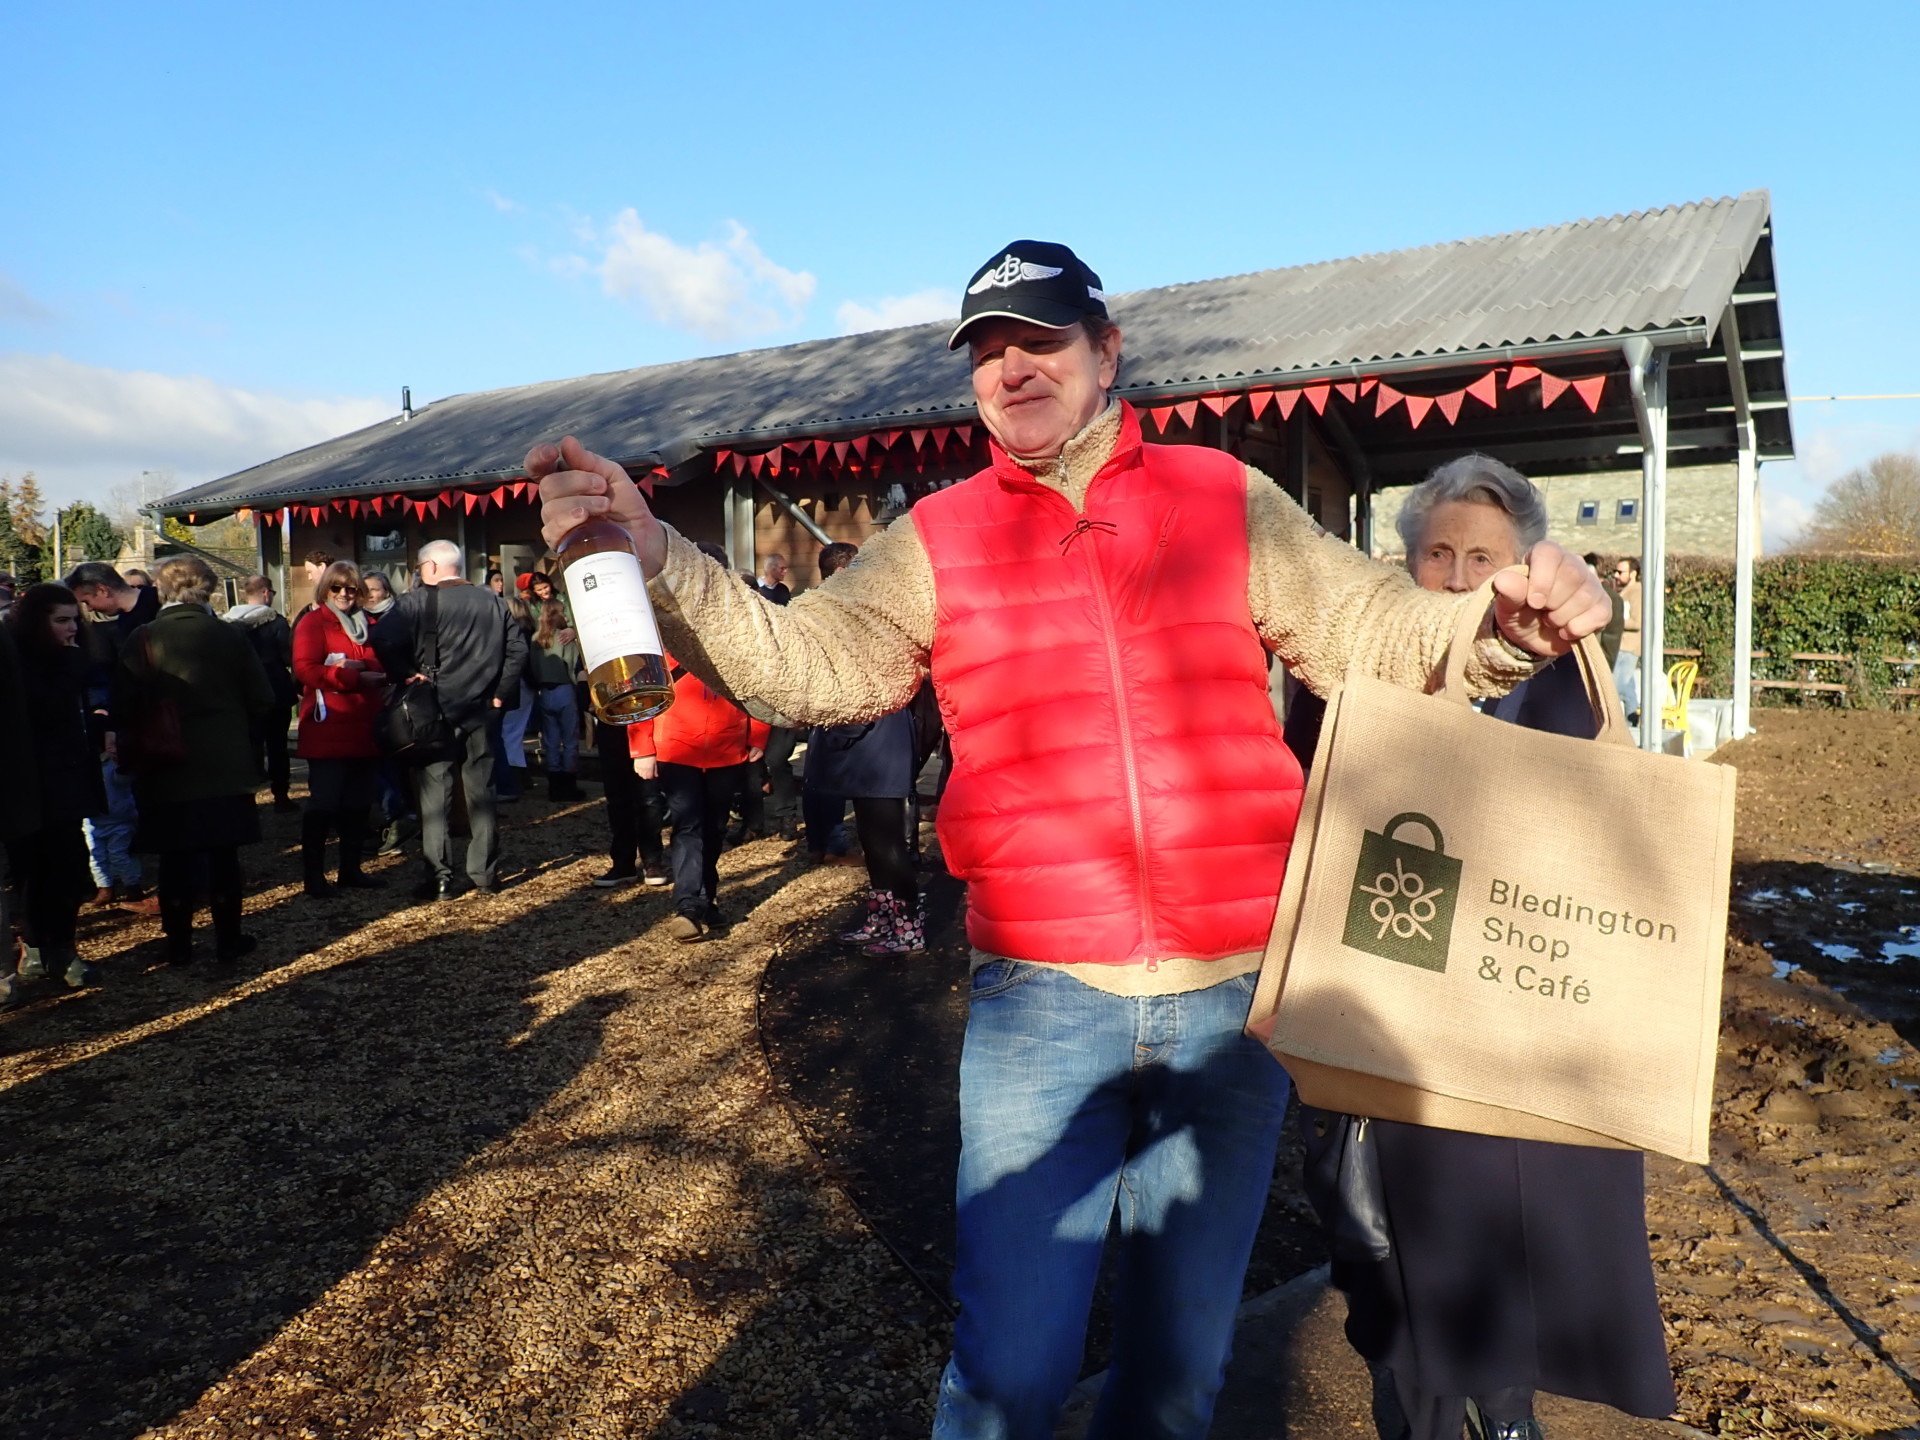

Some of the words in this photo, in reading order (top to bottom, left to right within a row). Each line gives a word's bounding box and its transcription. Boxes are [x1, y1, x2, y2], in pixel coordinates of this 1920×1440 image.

[1489, 879, 1677, 943] Bledington
[1482, 917, 1570, 962] Shop
[1478, 955, 1502, 983] &
[1514, 965, 1591, 1004] Café
